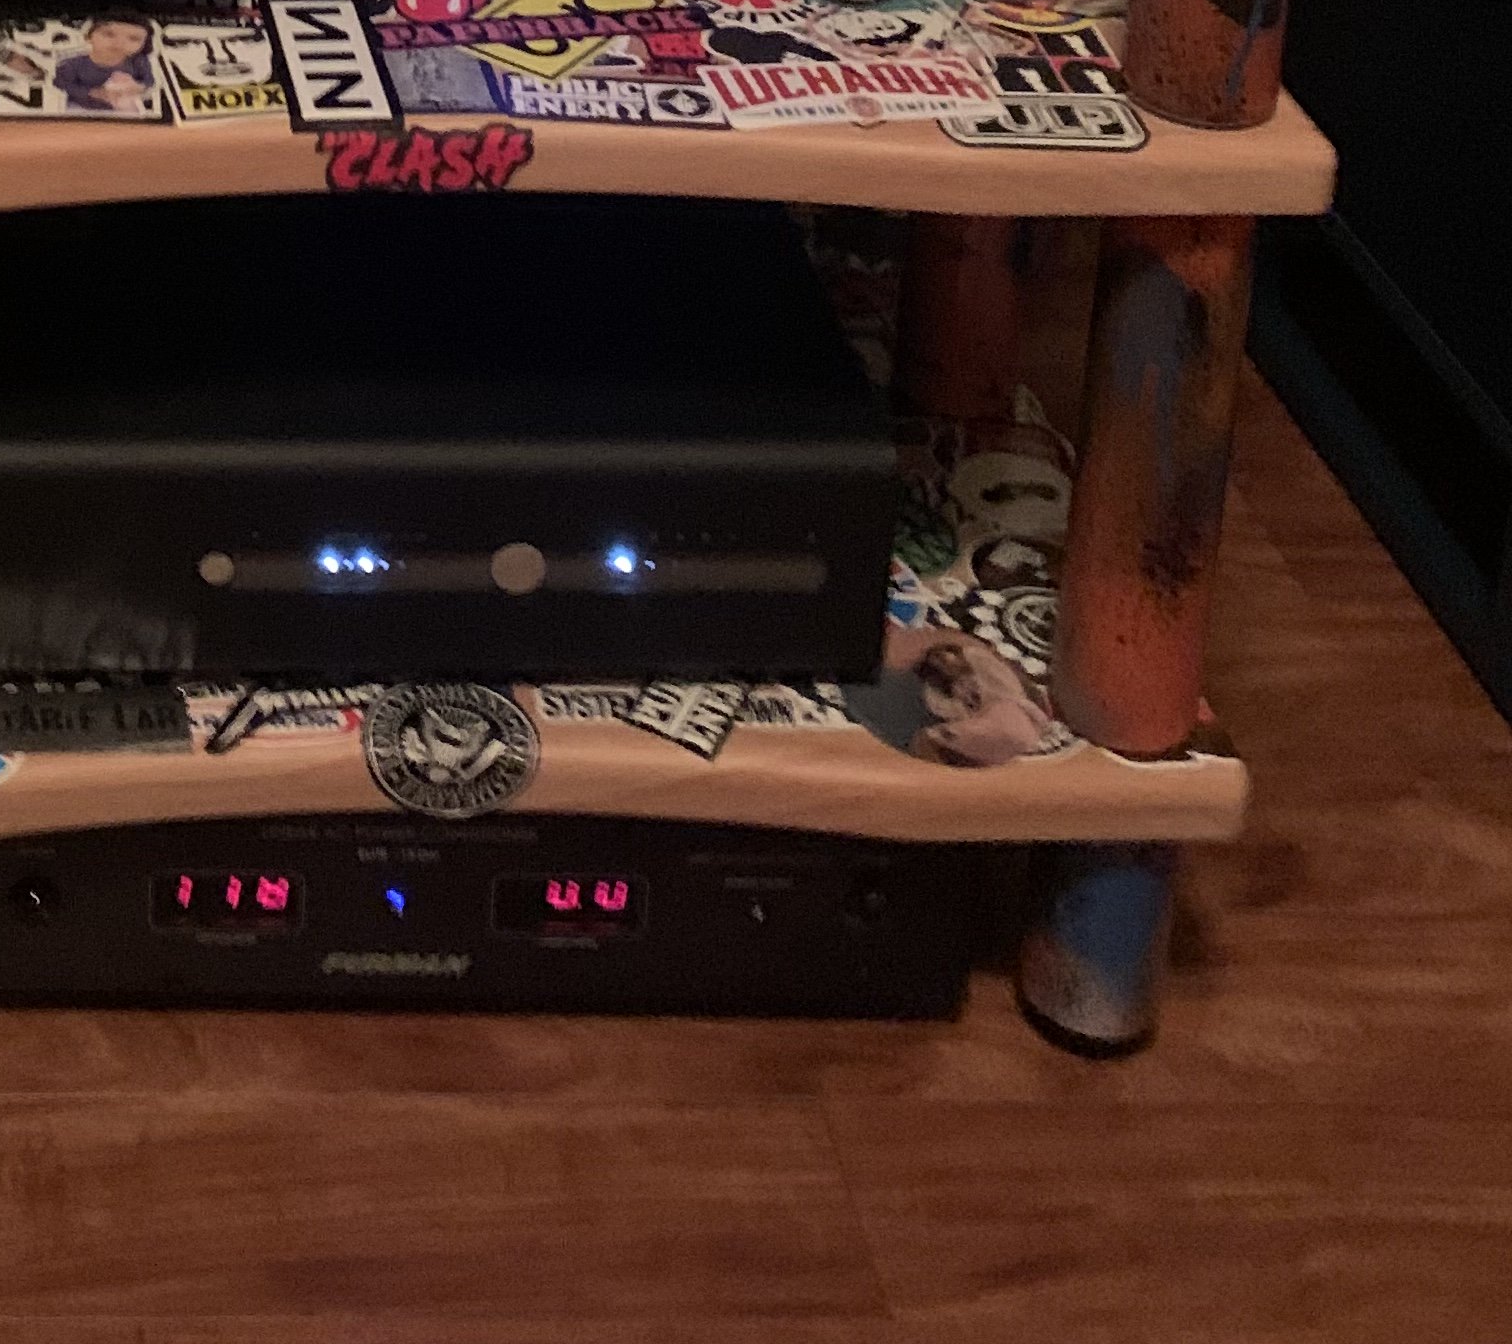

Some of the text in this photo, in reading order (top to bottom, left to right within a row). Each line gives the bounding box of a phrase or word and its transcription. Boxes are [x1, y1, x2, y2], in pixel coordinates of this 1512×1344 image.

[376, 6, 703, 51] PAPERBACK
[284, 6, 373, 111] NIN
[192, 84, 286, 112] NOFX
[509, 72, 646, 99] PUBLIC
[706, 60, 993, 110] LUCHADOR
[510, 96, 649, 121] ENEMY
[328, 124, 531, 194] CLASH
